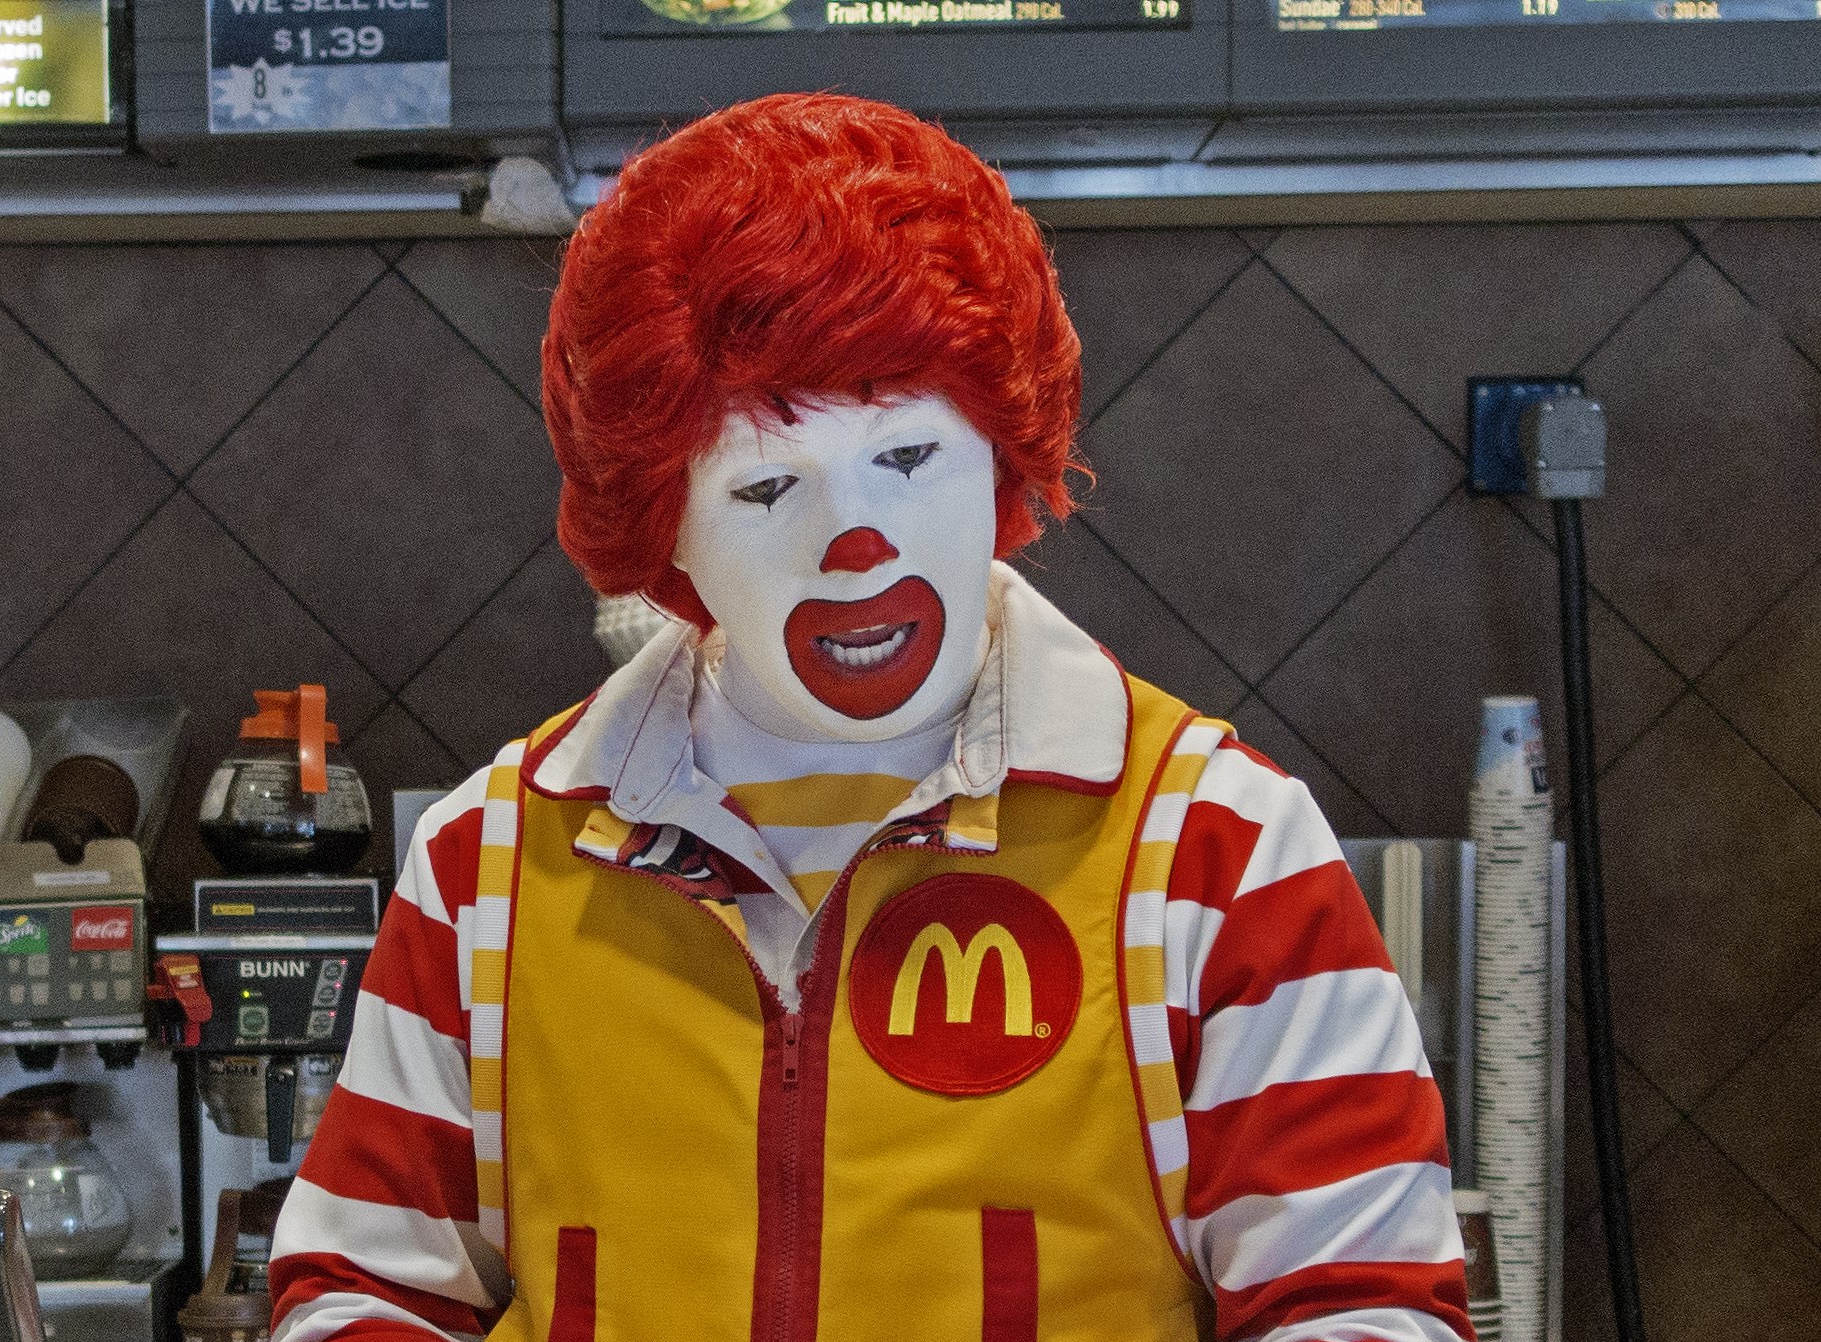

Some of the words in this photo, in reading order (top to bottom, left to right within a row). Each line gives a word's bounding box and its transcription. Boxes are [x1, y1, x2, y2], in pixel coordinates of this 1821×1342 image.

[827, 3, 870, 23] Fruit
[887, 2, 939, 26] Maple
[941, 0, 1013, 21] Oatmeal
[274, 26, 384, 59] $1.39
[15, 86, 51, 107] Ice
[239, 960, 306, 978] BUNN
